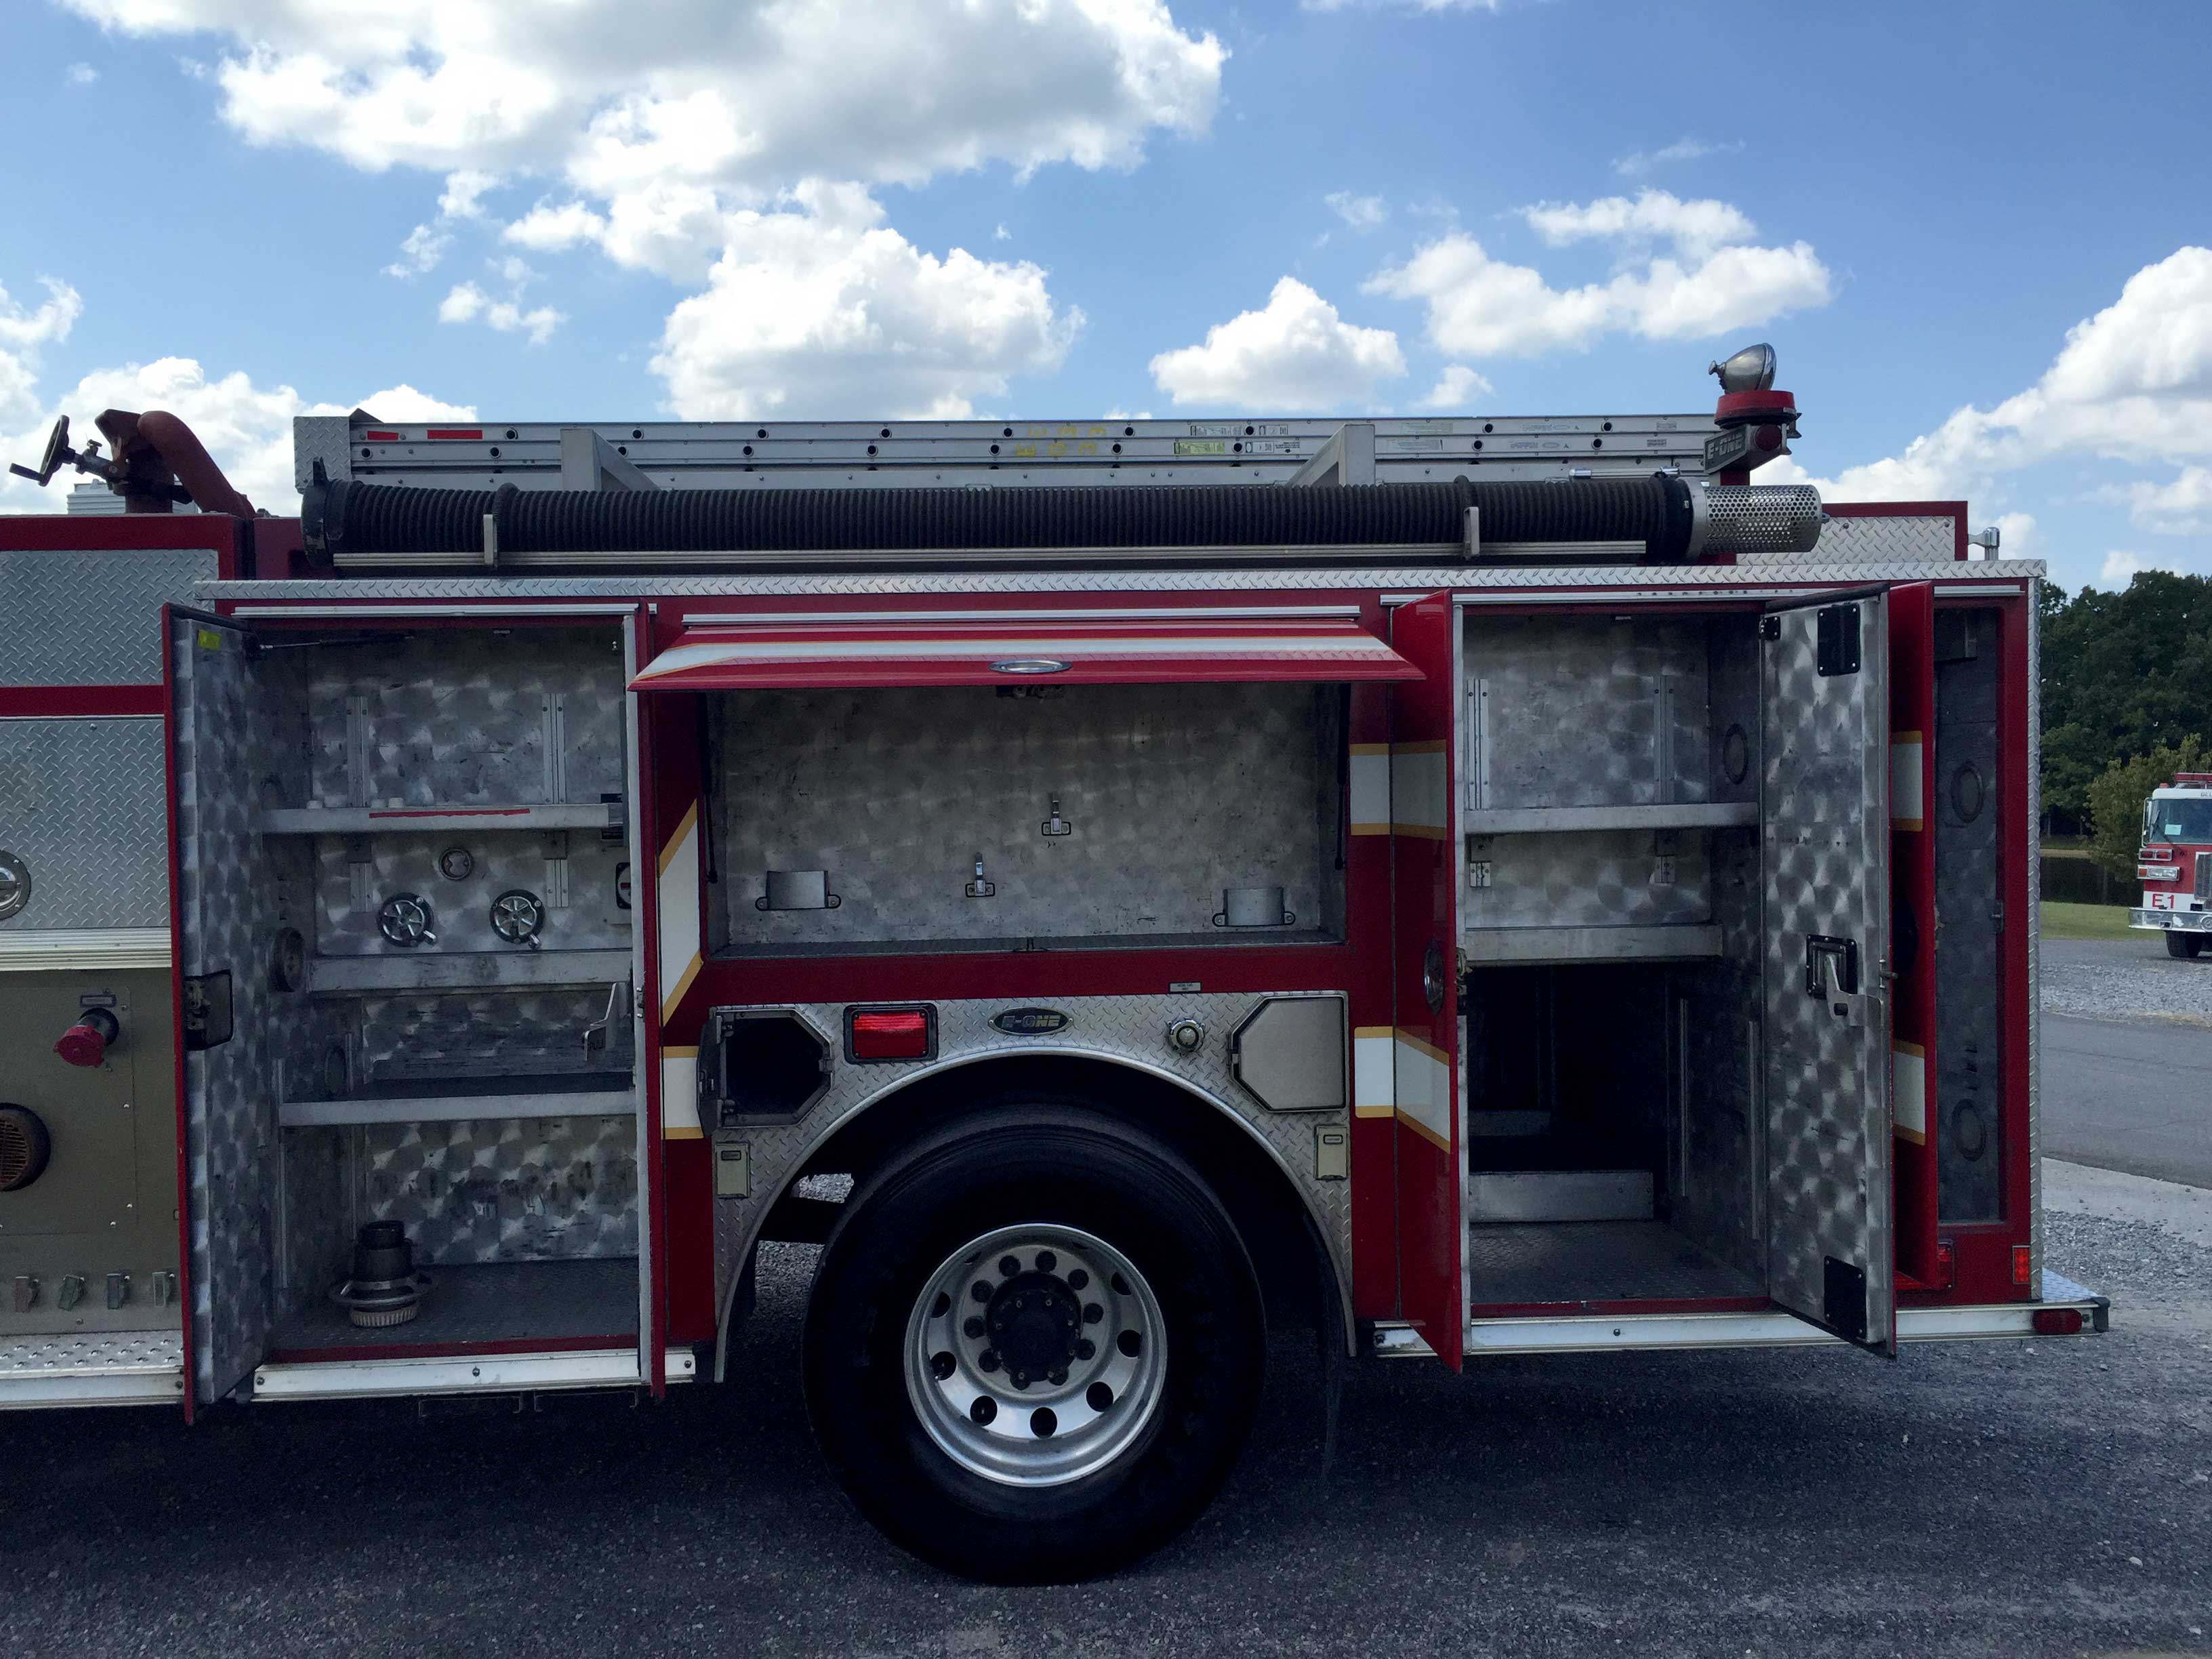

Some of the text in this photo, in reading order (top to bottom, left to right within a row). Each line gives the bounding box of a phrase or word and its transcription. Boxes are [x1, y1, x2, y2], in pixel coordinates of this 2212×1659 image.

[1708, 433, 1742, 459] E-ONE
[2152, 893, 2174, 909] E1
[1002, 1015, 1061, 1028] E-ONE
